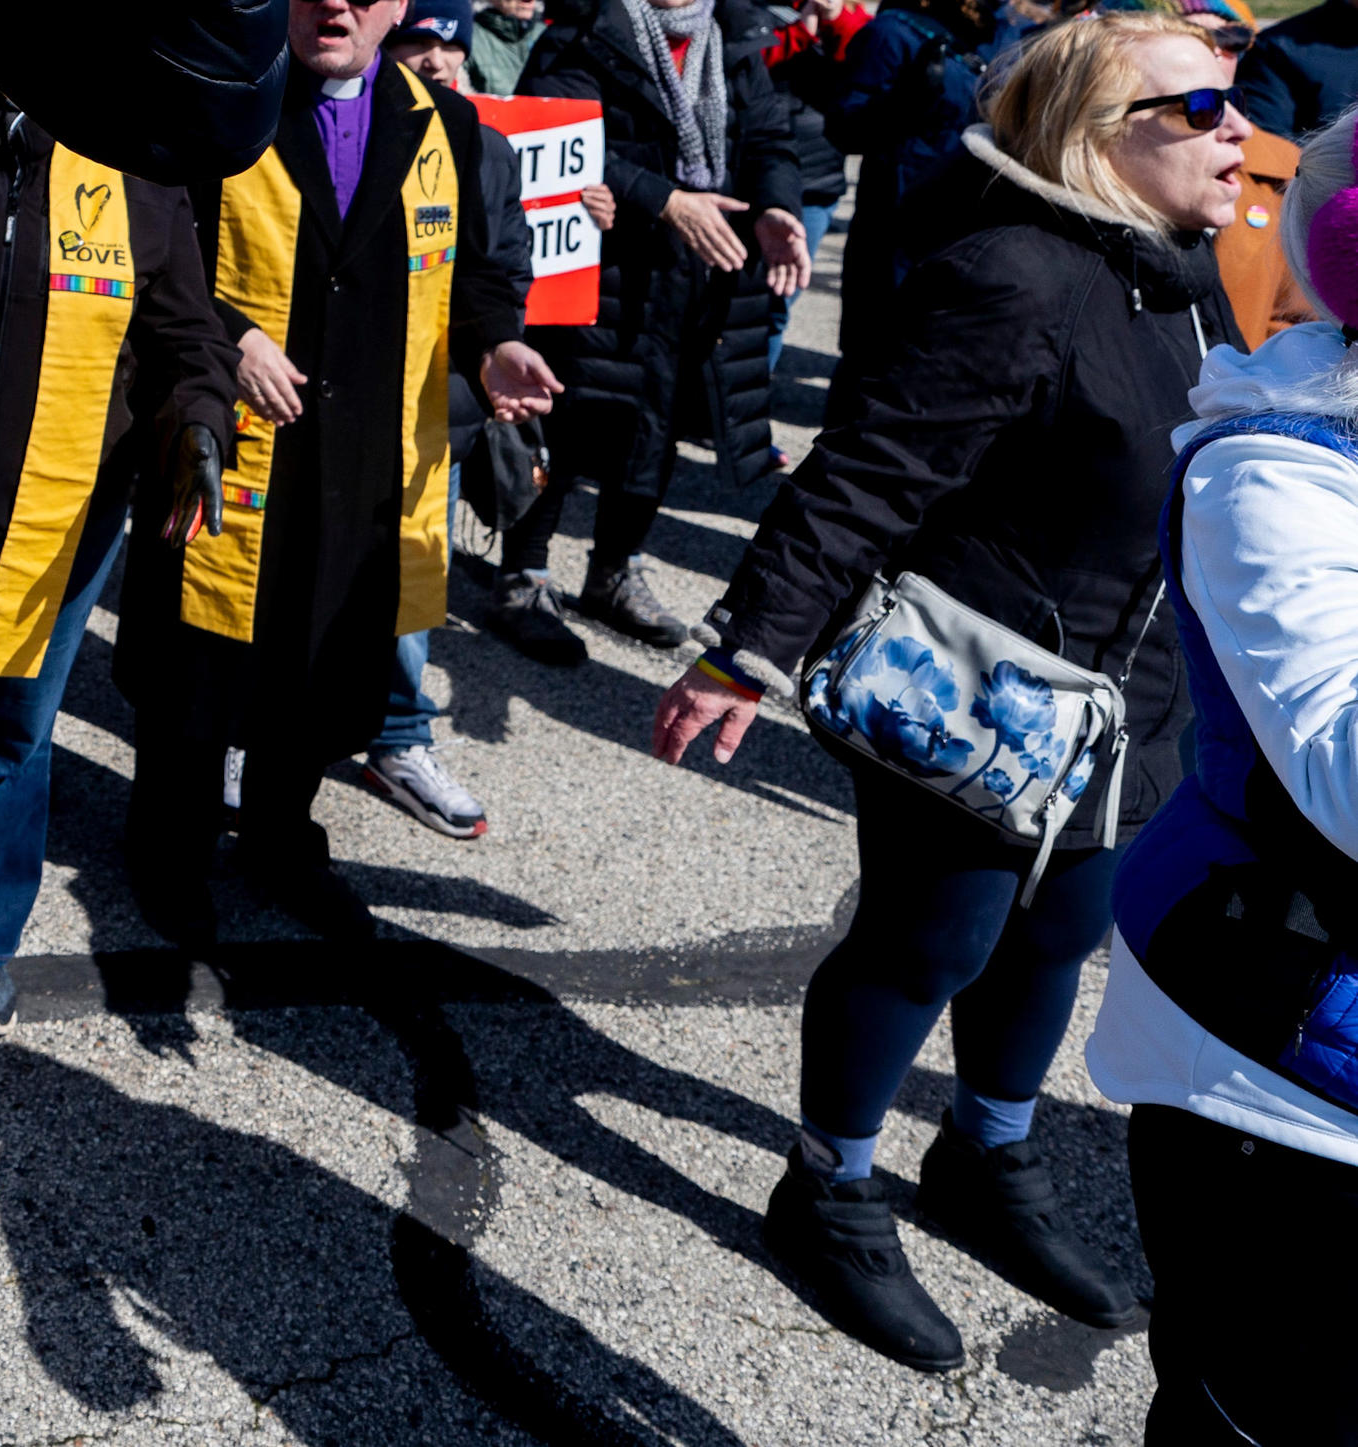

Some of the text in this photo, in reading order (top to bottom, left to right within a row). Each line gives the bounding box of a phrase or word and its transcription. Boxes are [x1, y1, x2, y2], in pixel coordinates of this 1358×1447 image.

[559, 137, 585, 178] IS
[415, 221, 453, 239] LOVE
[61, 246, 127, 267] LOVE
